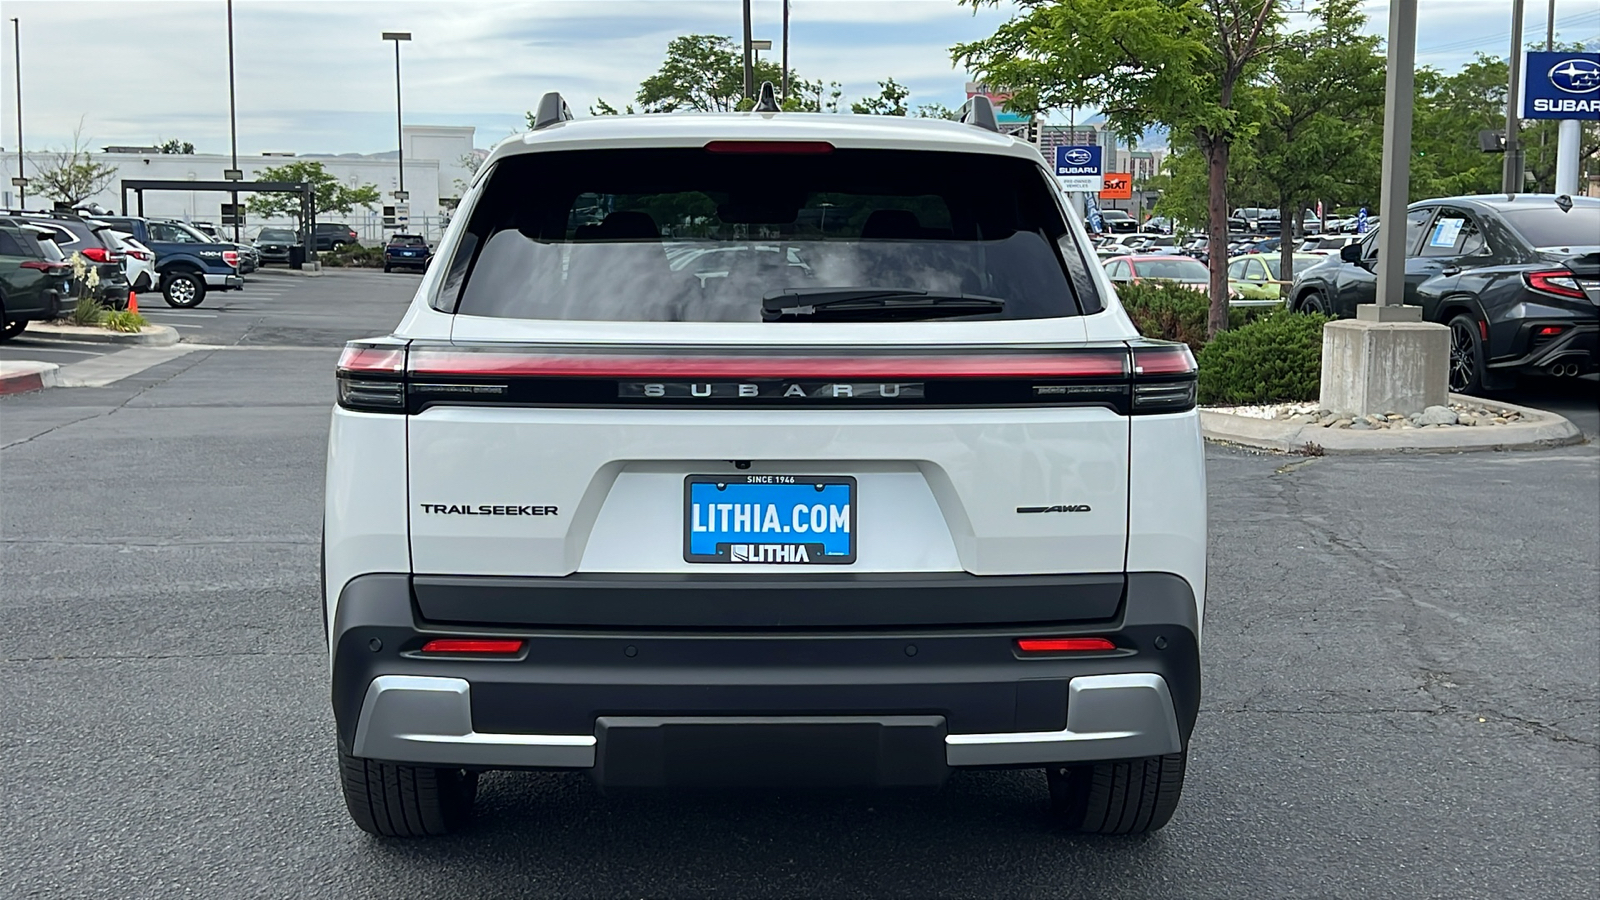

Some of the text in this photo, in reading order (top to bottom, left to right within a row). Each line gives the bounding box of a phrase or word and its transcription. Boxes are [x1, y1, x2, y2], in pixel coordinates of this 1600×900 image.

[1534, 99, 1600, 112] SUBAR
[644, 383, 900, 397] SUBARU
[747, 475, 795, 484] SINCE 1946
[420, 503, 558, 516] TRAILSEEKER
[1044, 504, 1092, 513] AWD
[692, 503, 850, 533] LITHIA.COM
[748, 544, 810, 562] LITHIA
